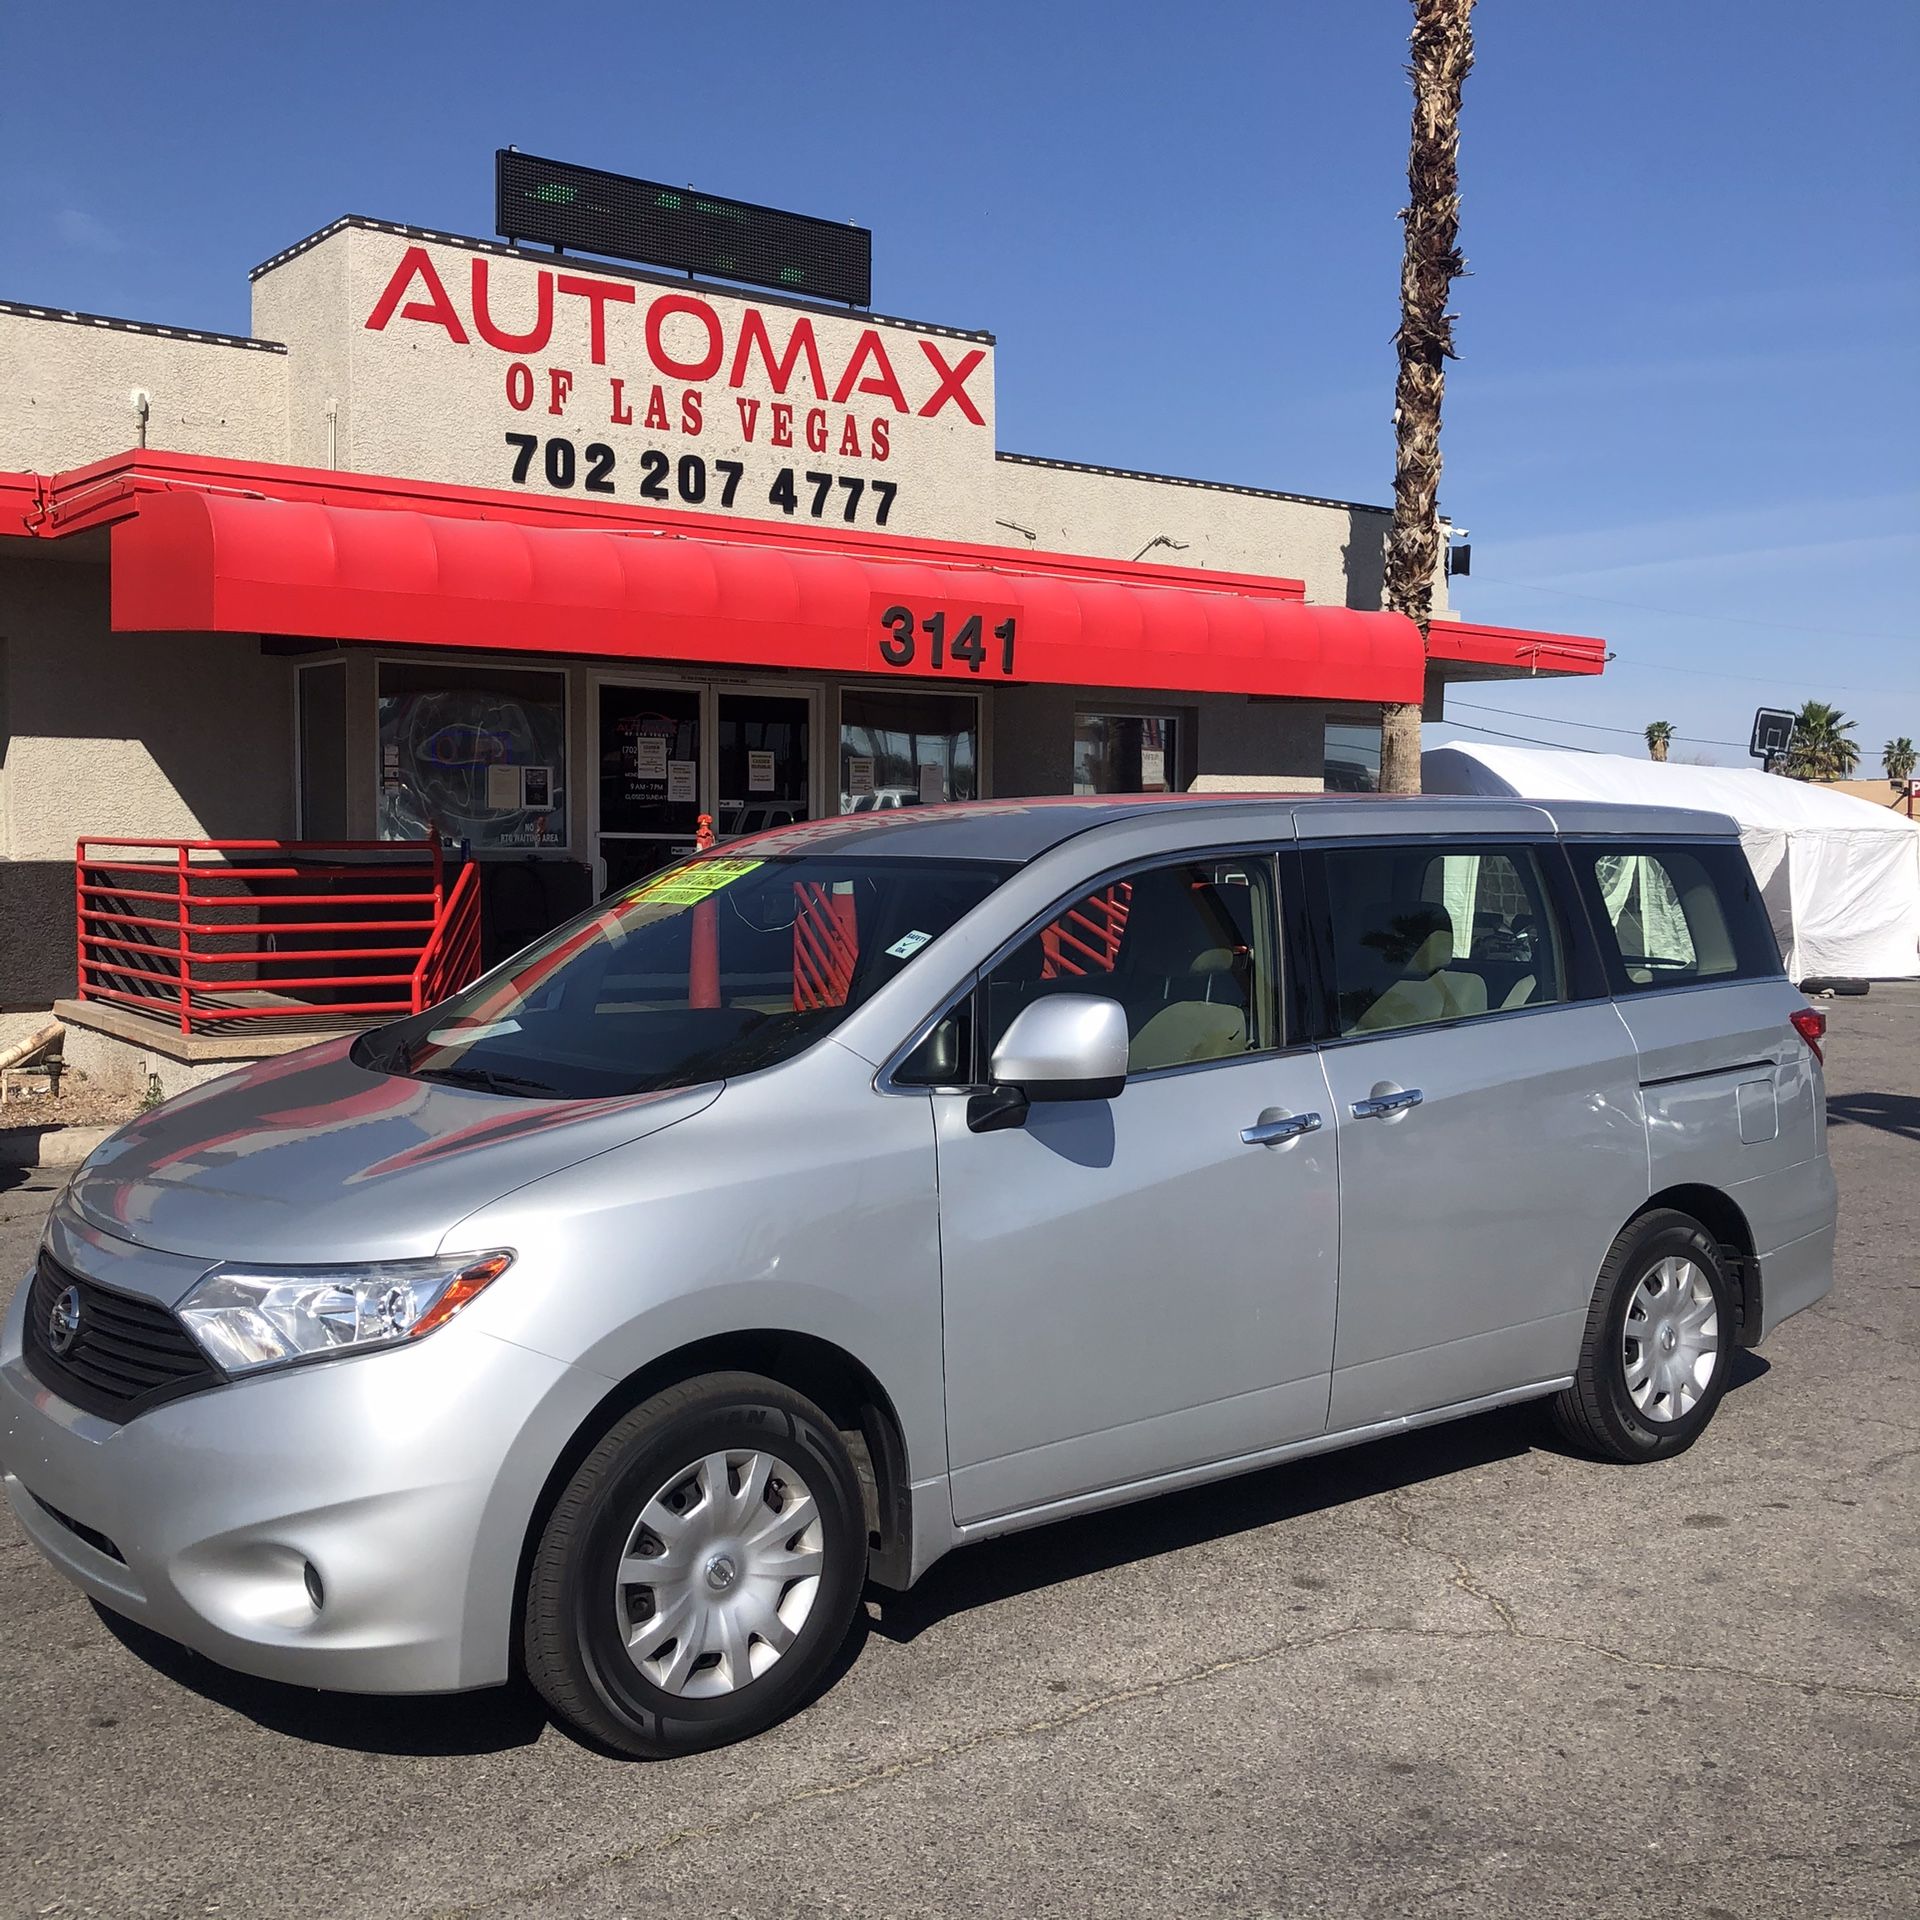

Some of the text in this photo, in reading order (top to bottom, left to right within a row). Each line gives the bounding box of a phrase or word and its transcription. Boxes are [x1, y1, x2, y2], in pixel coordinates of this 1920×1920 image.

[364, 246, 986, 425] AUTOMAX
[506, 362, 890, 462] OF LAS VEGAS
[505, 432, 898, 526] 702 207 4777
[879, 605, 1016, 675] 3141
[524, 823, 535, 832] NO
[543, 833, 559, 843] AREA
